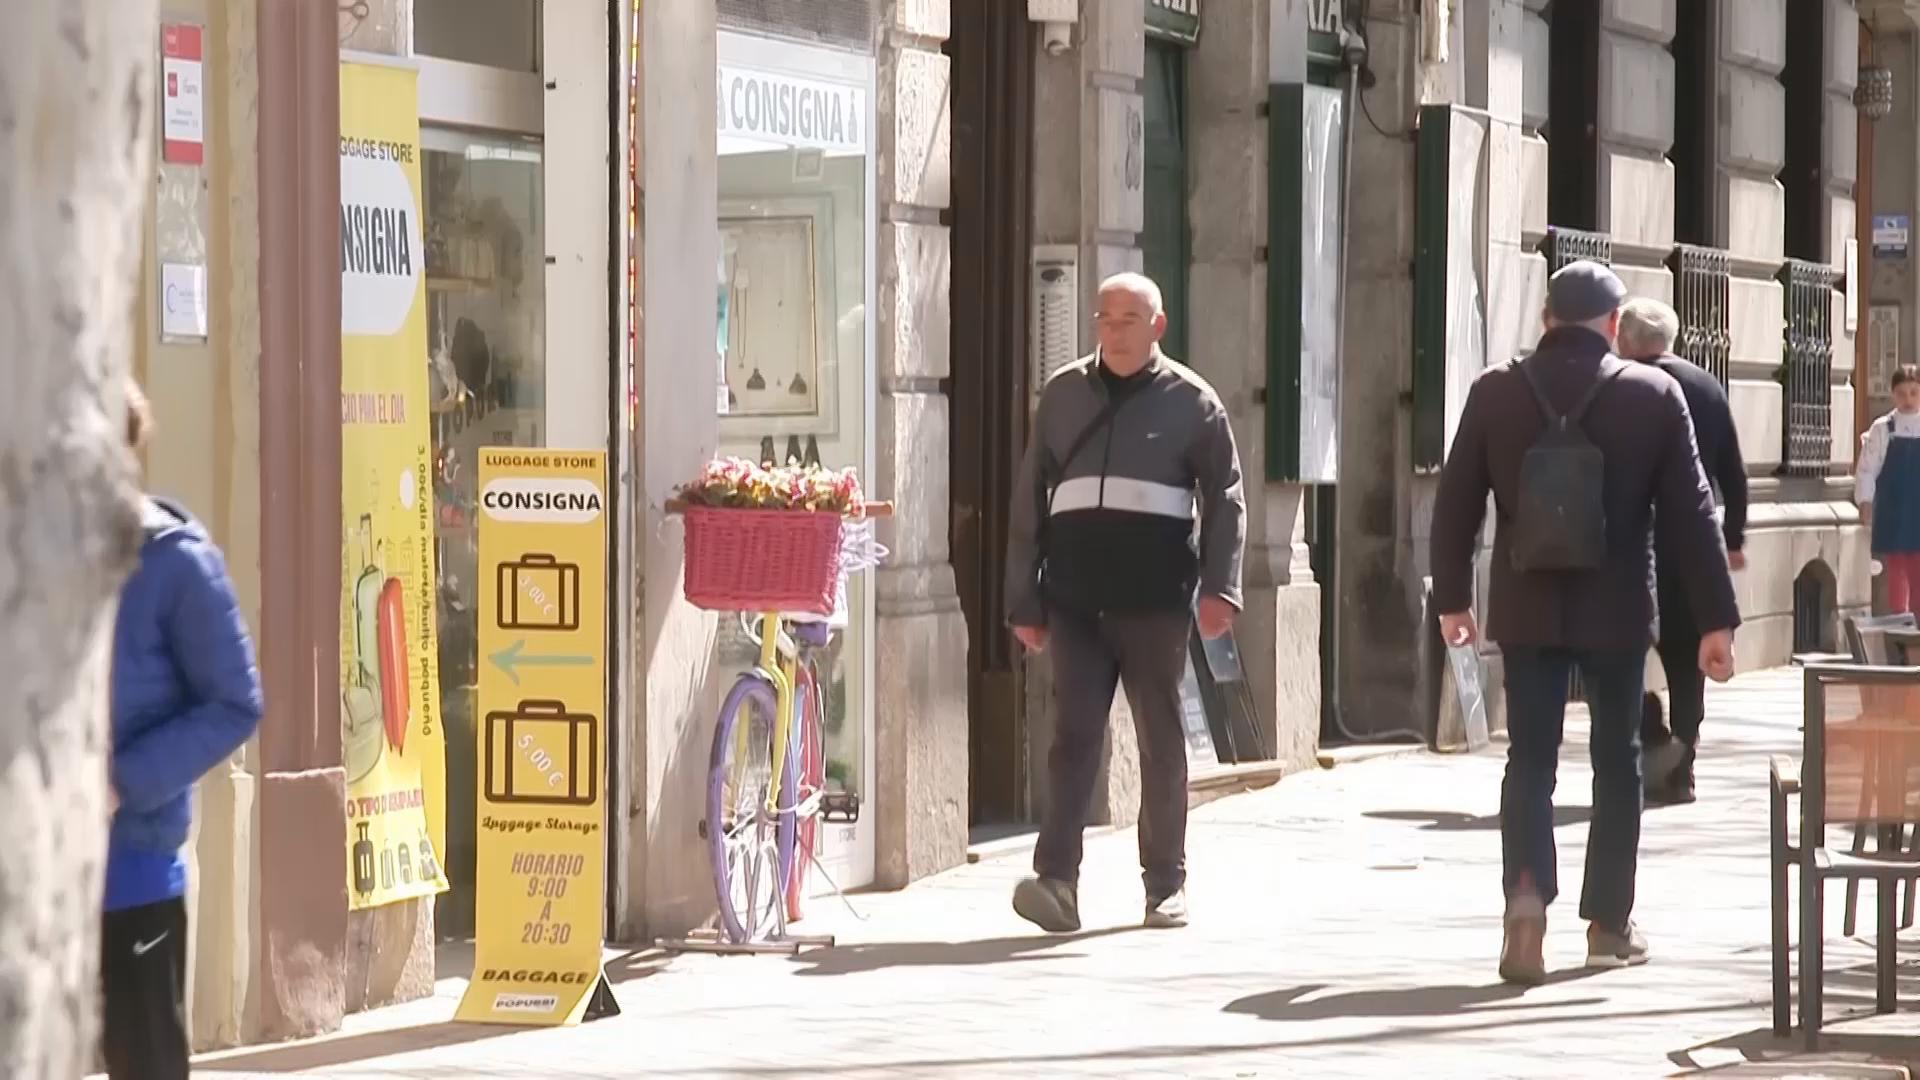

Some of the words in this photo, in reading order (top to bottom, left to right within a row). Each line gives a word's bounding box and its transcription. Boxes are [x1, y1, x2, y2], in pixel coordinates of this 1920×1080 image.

[731, 76, 844, 143] CONSIGNA
[378, 140, 414, 164] STORE
[378, 393, 389, 424] EL
[486, 455, 550, 468] LUGGAGE
[553, 457, 597, 469] STORE
[484, 491, 601, 512] CONSIGNA
[482, 816, 541, 834] Luggage
[545, 817, 598, 835] Storage
[511, 852, 584, 876] HORARIO
[527, 876, 567, 898] 9:00
[540, 900, 552, 921] A
[521, 922, 571, 944] 20:30
[482, 969, 589, 984] BAGGAGE
